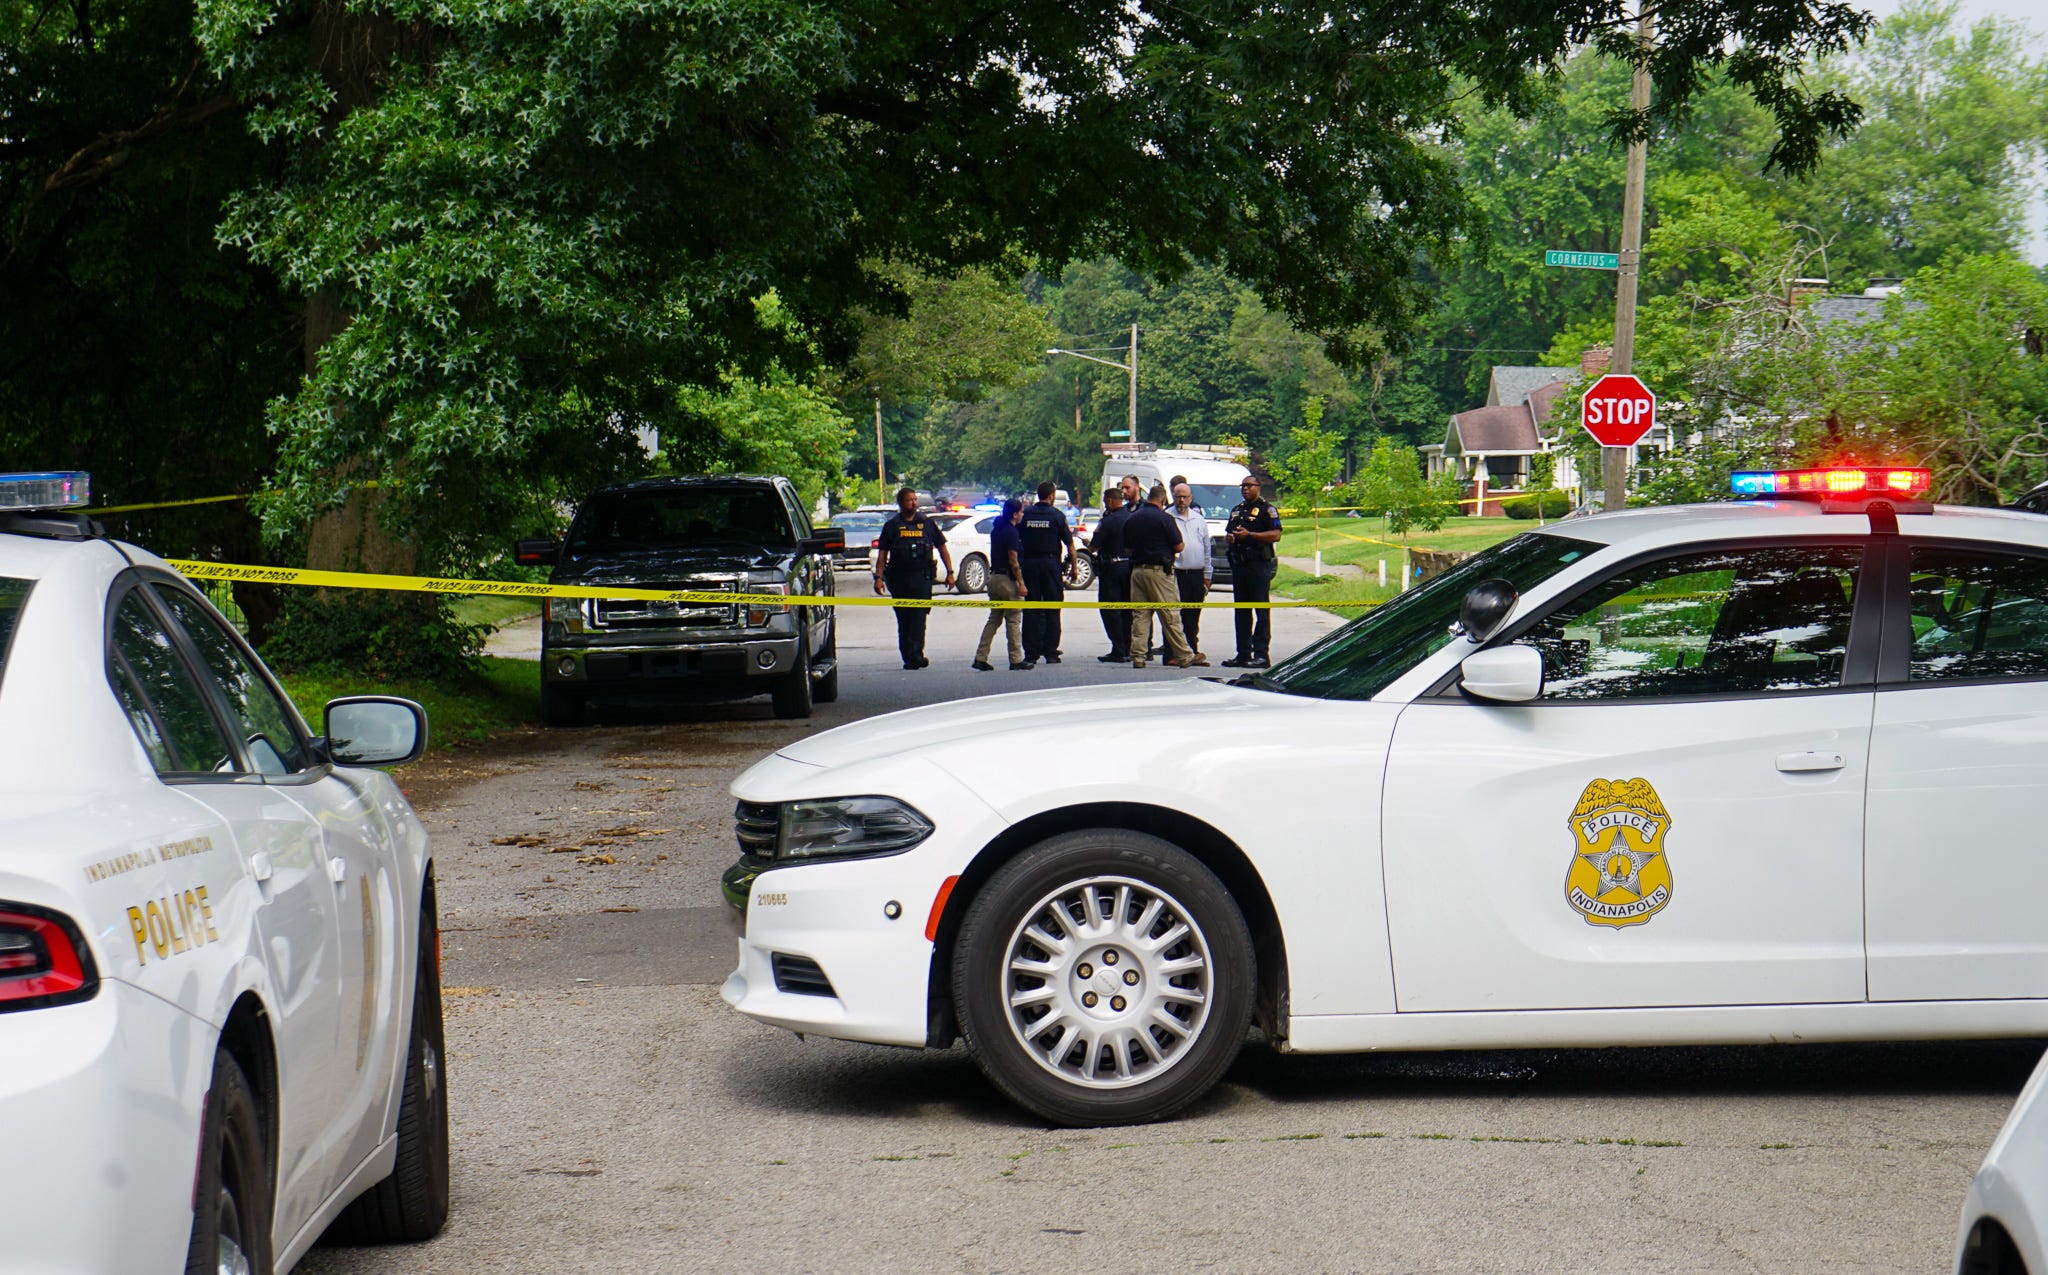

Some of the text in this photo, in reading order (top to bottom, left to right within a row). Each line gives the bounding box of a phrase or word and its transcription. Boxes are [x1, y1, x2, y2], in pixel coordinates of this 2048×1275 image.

[1551, 253, 1605, 267] CORNELIUS
[1587, 398, 1650, 425] STOP
[196, 565, 223, 576] LINE
[220, 567, 240, 578] DO
[238, 569, 264, 579] NOT
[261, 570, 299, 581] CROSS
[422, 580, 553, 594] POLICE LINE DO NOT CROSS
[1588, 813, 1654, 833] POLICE
[1601, 850, 1638, 873] MARION COUNTY
[757, 893, 788, 906] 210665
[1571, 889, 1667, 916] INDIANAPOLIS
[126, 885, 219, 967] POLICE
